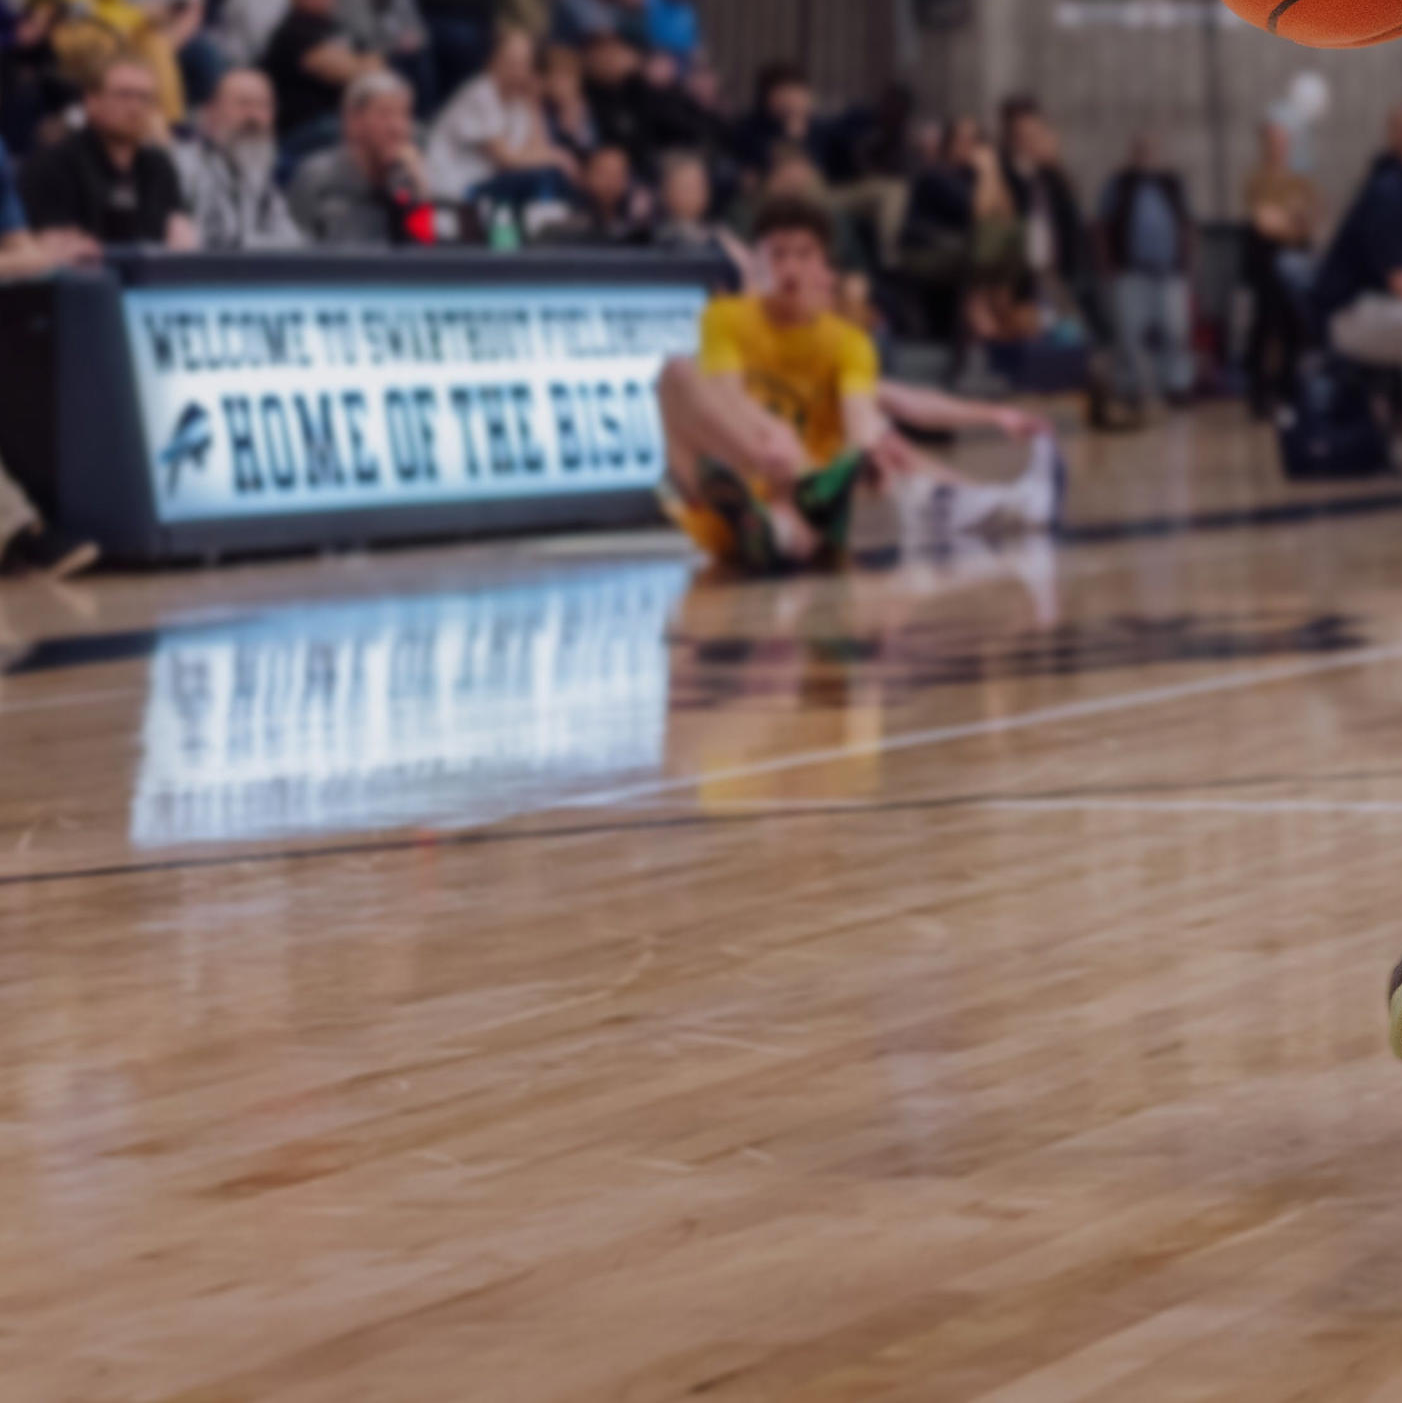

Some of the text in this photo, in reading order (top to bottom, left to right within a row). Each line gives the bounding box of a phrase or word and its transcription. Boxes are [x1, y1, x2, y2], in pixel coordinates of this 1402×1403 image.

[143, 311, 312, 374] WELCOME
[317, 310, 358, 365] TO
[220, 380, 659, 493] HOME OF THE BISO
